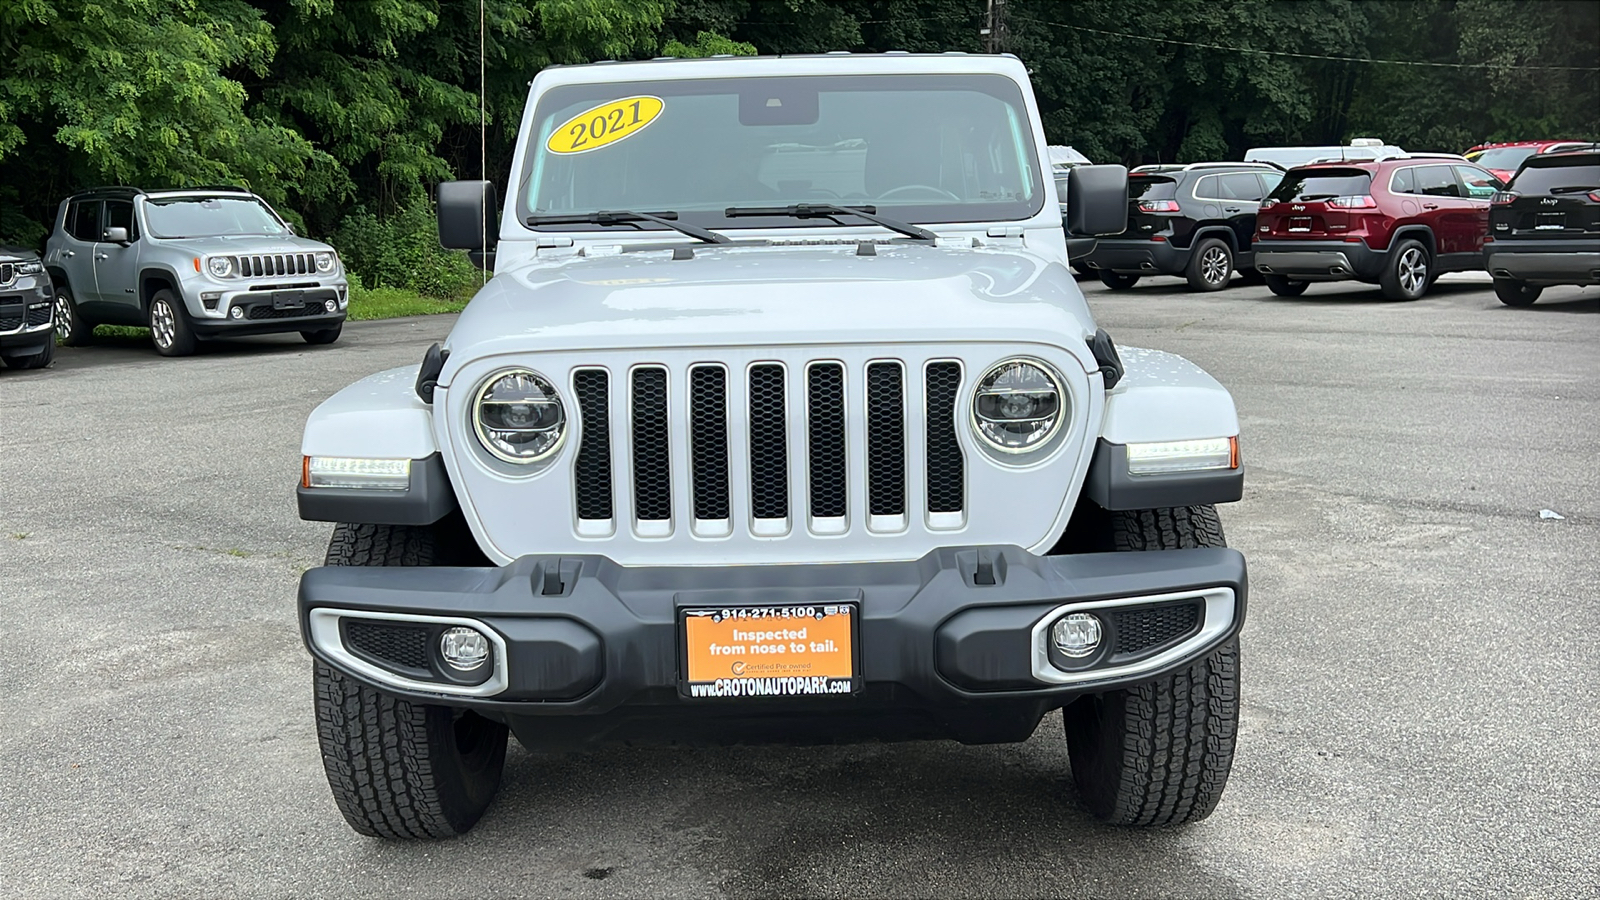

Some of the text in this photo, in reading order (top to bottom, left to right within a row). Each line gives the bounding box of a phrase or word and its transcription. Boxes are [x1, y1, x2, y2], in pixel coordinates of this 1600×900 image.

[569, 100, 643, 150] 2021
[721, 607, 815, 619] 914-271-5100
[733, 628, 807, 643] Inspected
[709, 640, 839, 656] from nose to tail.
[745, 663, 775, 671] Certified
